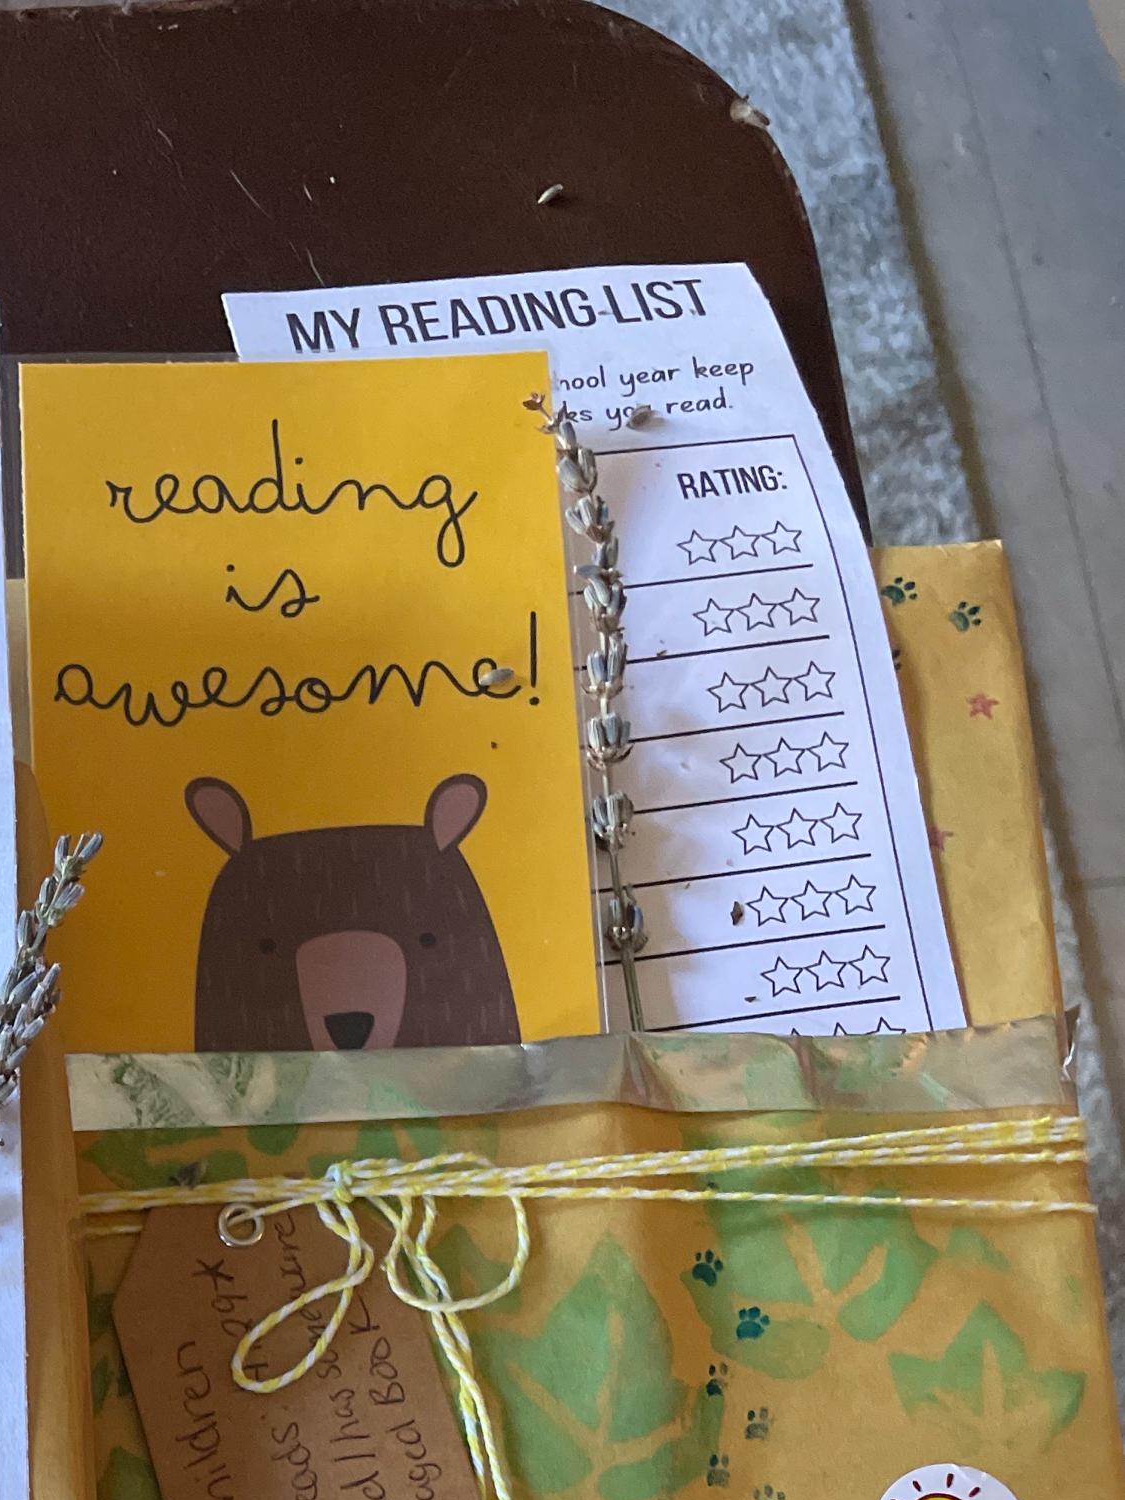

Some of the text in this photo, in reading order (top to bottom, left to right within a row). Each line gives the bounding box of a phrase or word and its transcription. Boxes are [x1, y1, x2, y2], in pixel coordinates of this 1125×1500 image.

[285, 278, 707, 354] MY READING LIST
[619, 367, 681, 397] year
[692, 356, 754, 386] keep
[666, 386, 733, 415] read.
[105, 418, 479, 569] reading
[677, 464, 787, 500] RATING:
[225, 564, 320, 619] is
[54, 611, 541, 728] awesome!
